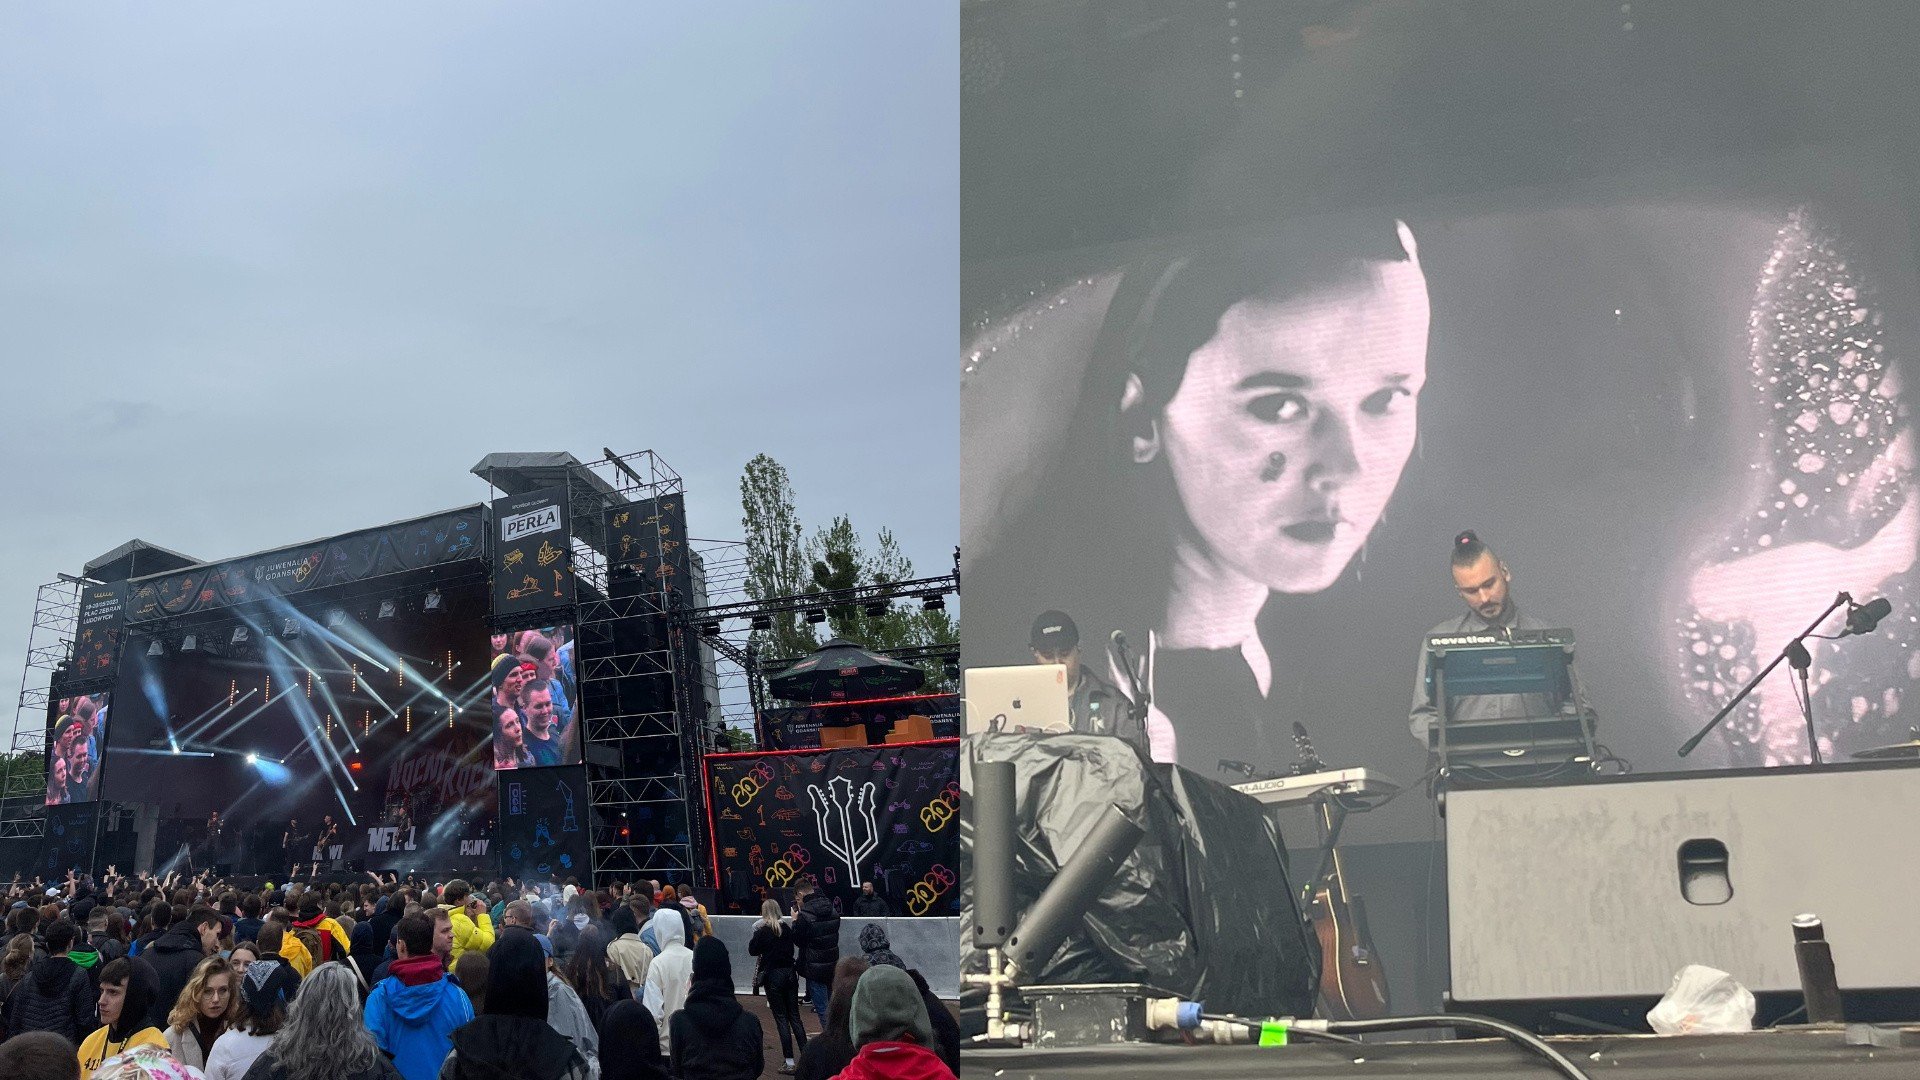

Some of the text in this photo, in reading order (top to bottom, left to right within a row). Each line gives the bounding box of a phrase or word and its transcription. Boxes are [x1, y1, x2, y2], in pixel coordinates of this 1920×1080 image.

[507, 511, 556, 535] PERŁA
[266, 557, 309, 572] JUWENALIA
[82, 613, 114, 625] LUDOWYCH
[84, 609, 98, 617] PLAC
[1431, 636, 1496, 646] novation
[367, 825, 417, 852] METL
[459, 839, 490, 856] PANY
